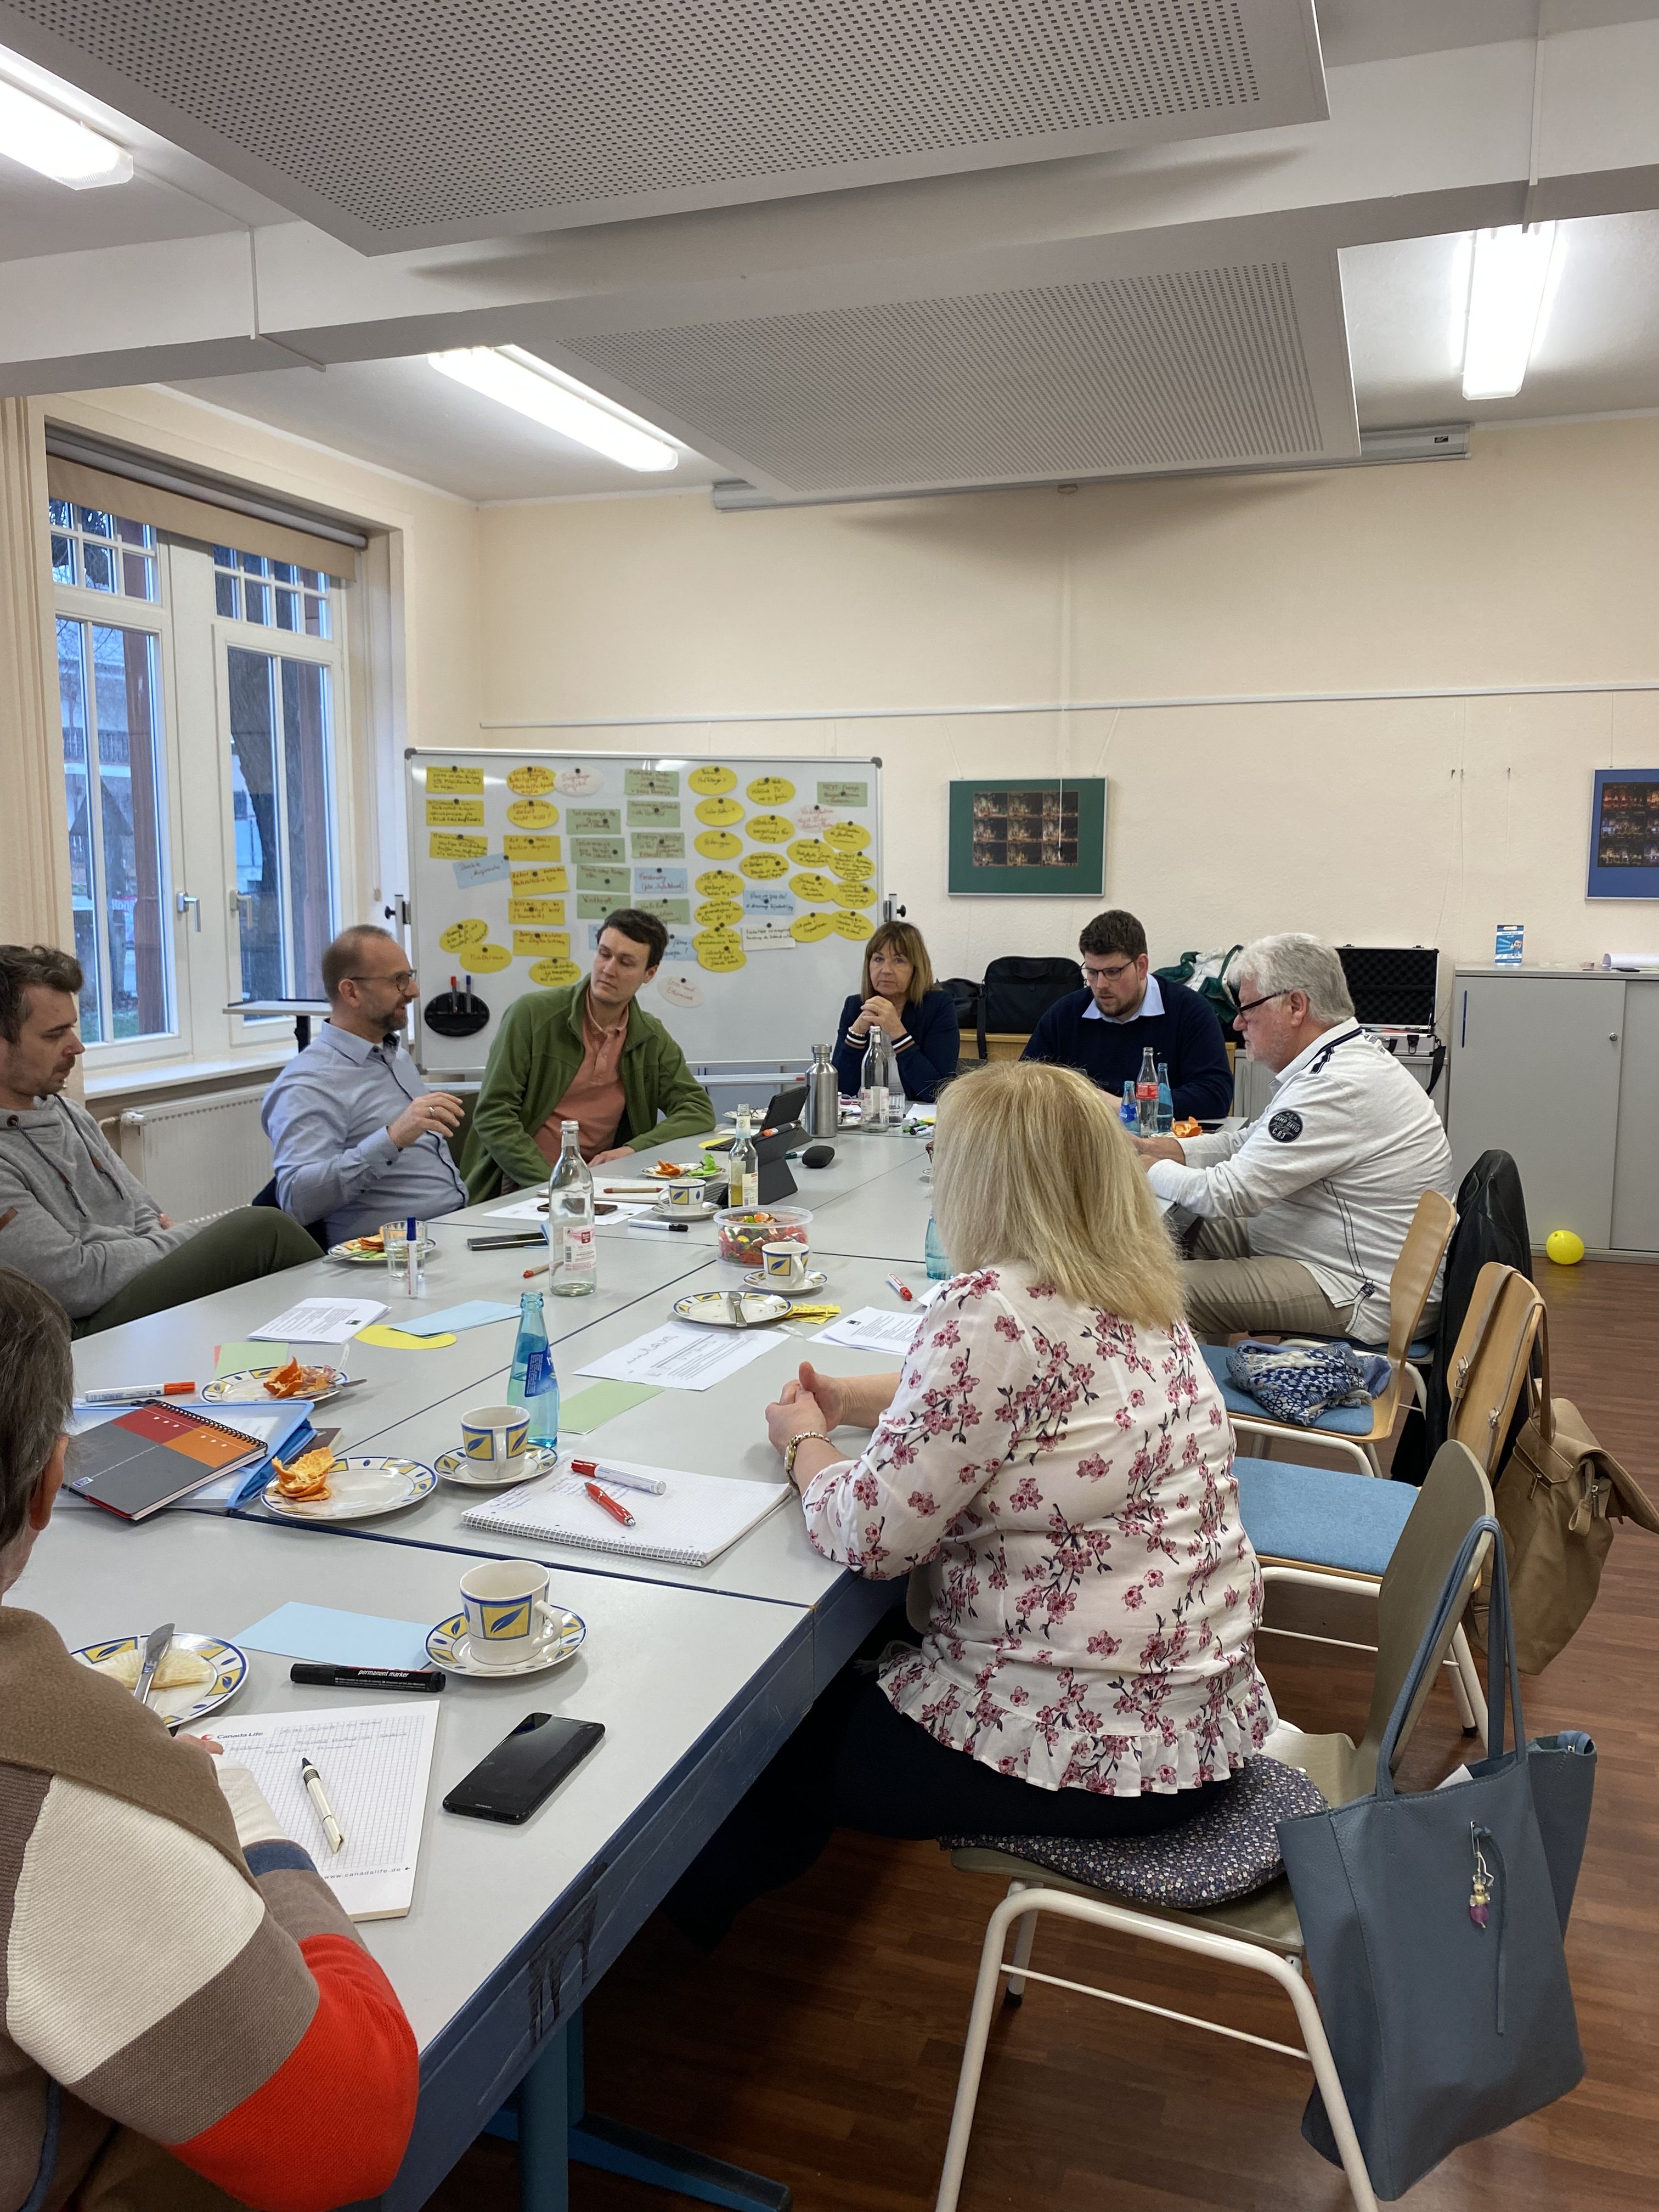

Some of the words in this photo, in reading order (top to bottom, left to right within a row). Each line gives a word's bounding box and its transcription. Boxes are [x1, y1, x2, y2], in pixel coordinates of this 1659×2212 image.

[1274, 1115, 1288, 1124] CAMP
[1286, 1121, 1300, 1132] DAVID
[324, 1867, 401, 1880] www.canadalife.de
